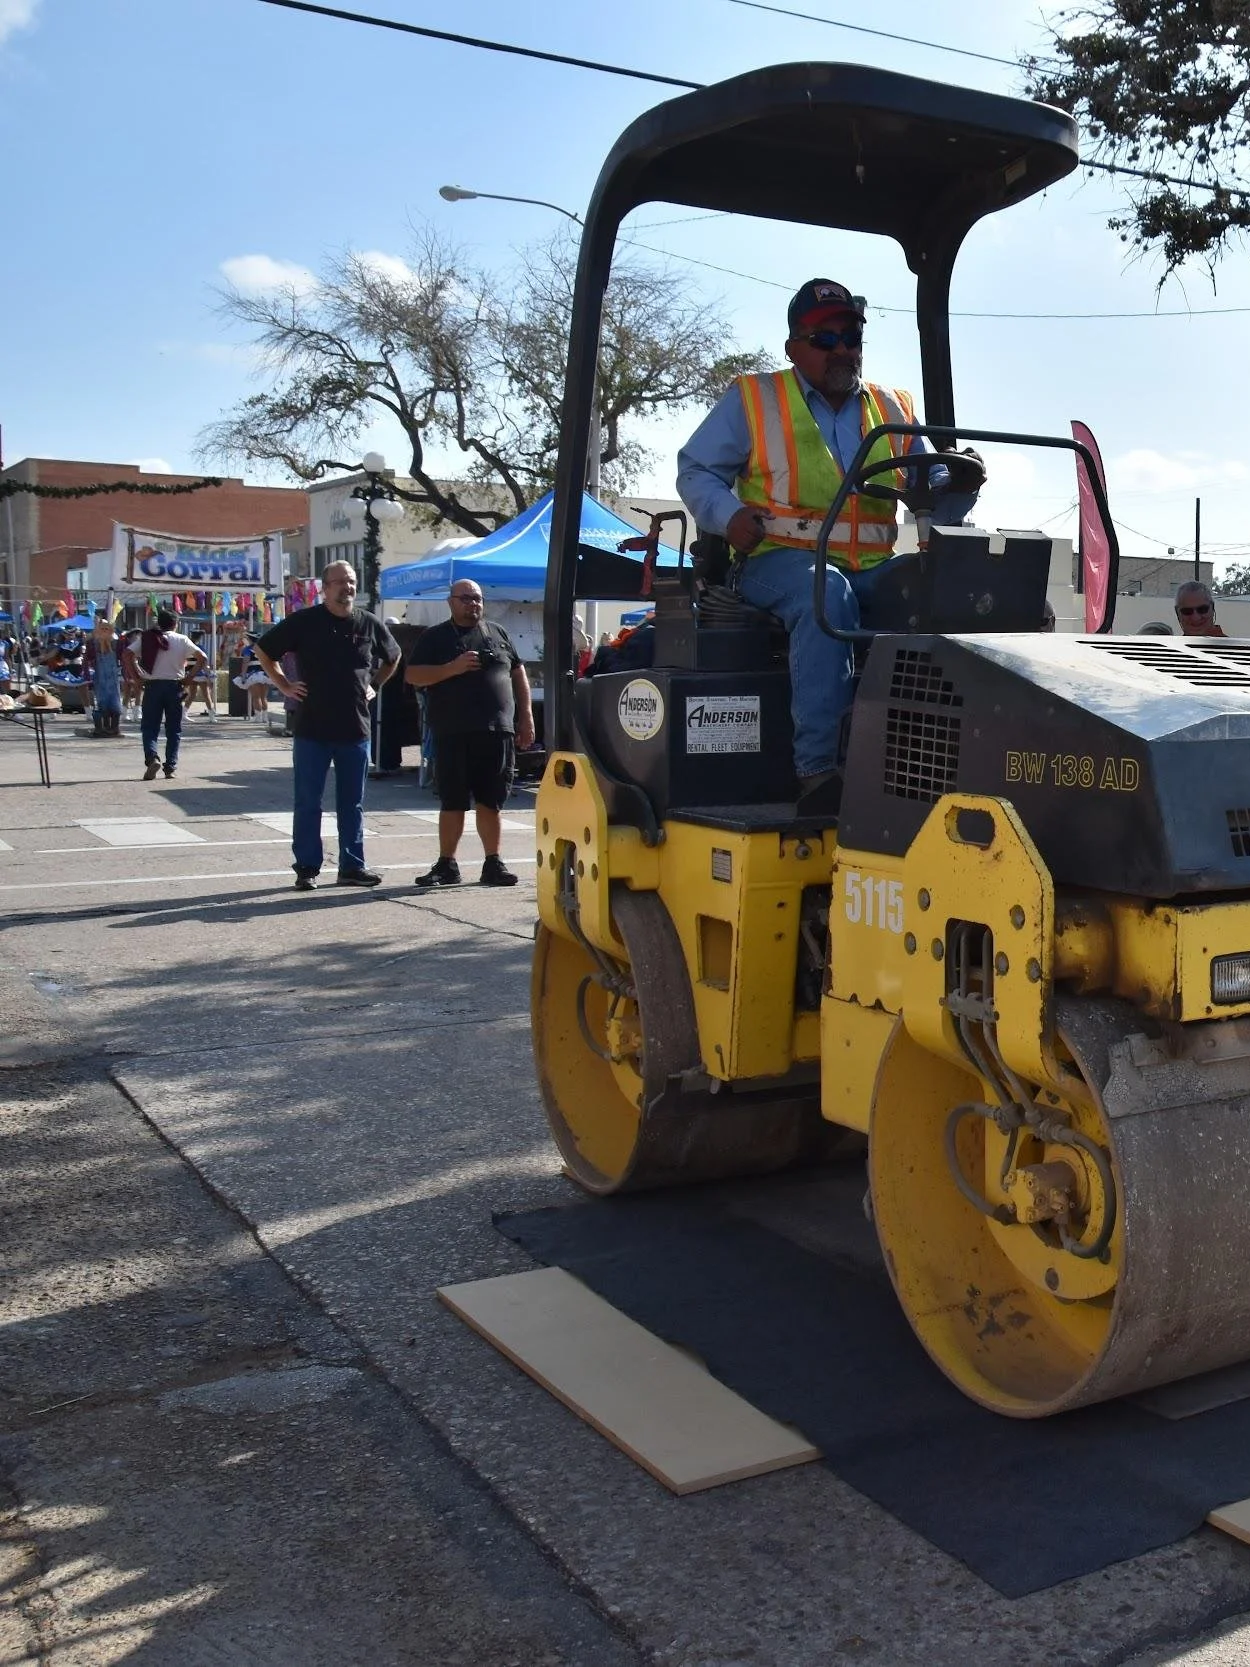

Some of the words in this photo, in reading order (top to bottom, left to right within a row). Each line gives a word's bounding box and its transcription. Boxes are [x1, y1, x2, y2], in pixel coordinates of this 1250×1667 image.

[139, 553, 261, 581] Corral
[687, 704, 759, 728] ANDERSON
[687, 743, 709, 753] RENTAL
[711, 743, 728, 752] FLEET
[730, 742, 760, 752] EQUIPMENT
[1005, 751, 1046, 784] BW
[1051, 754, 1095, 788] 138
[1099, 757, 1140, 792] AD
[845, 871, 905, 934] 5115
